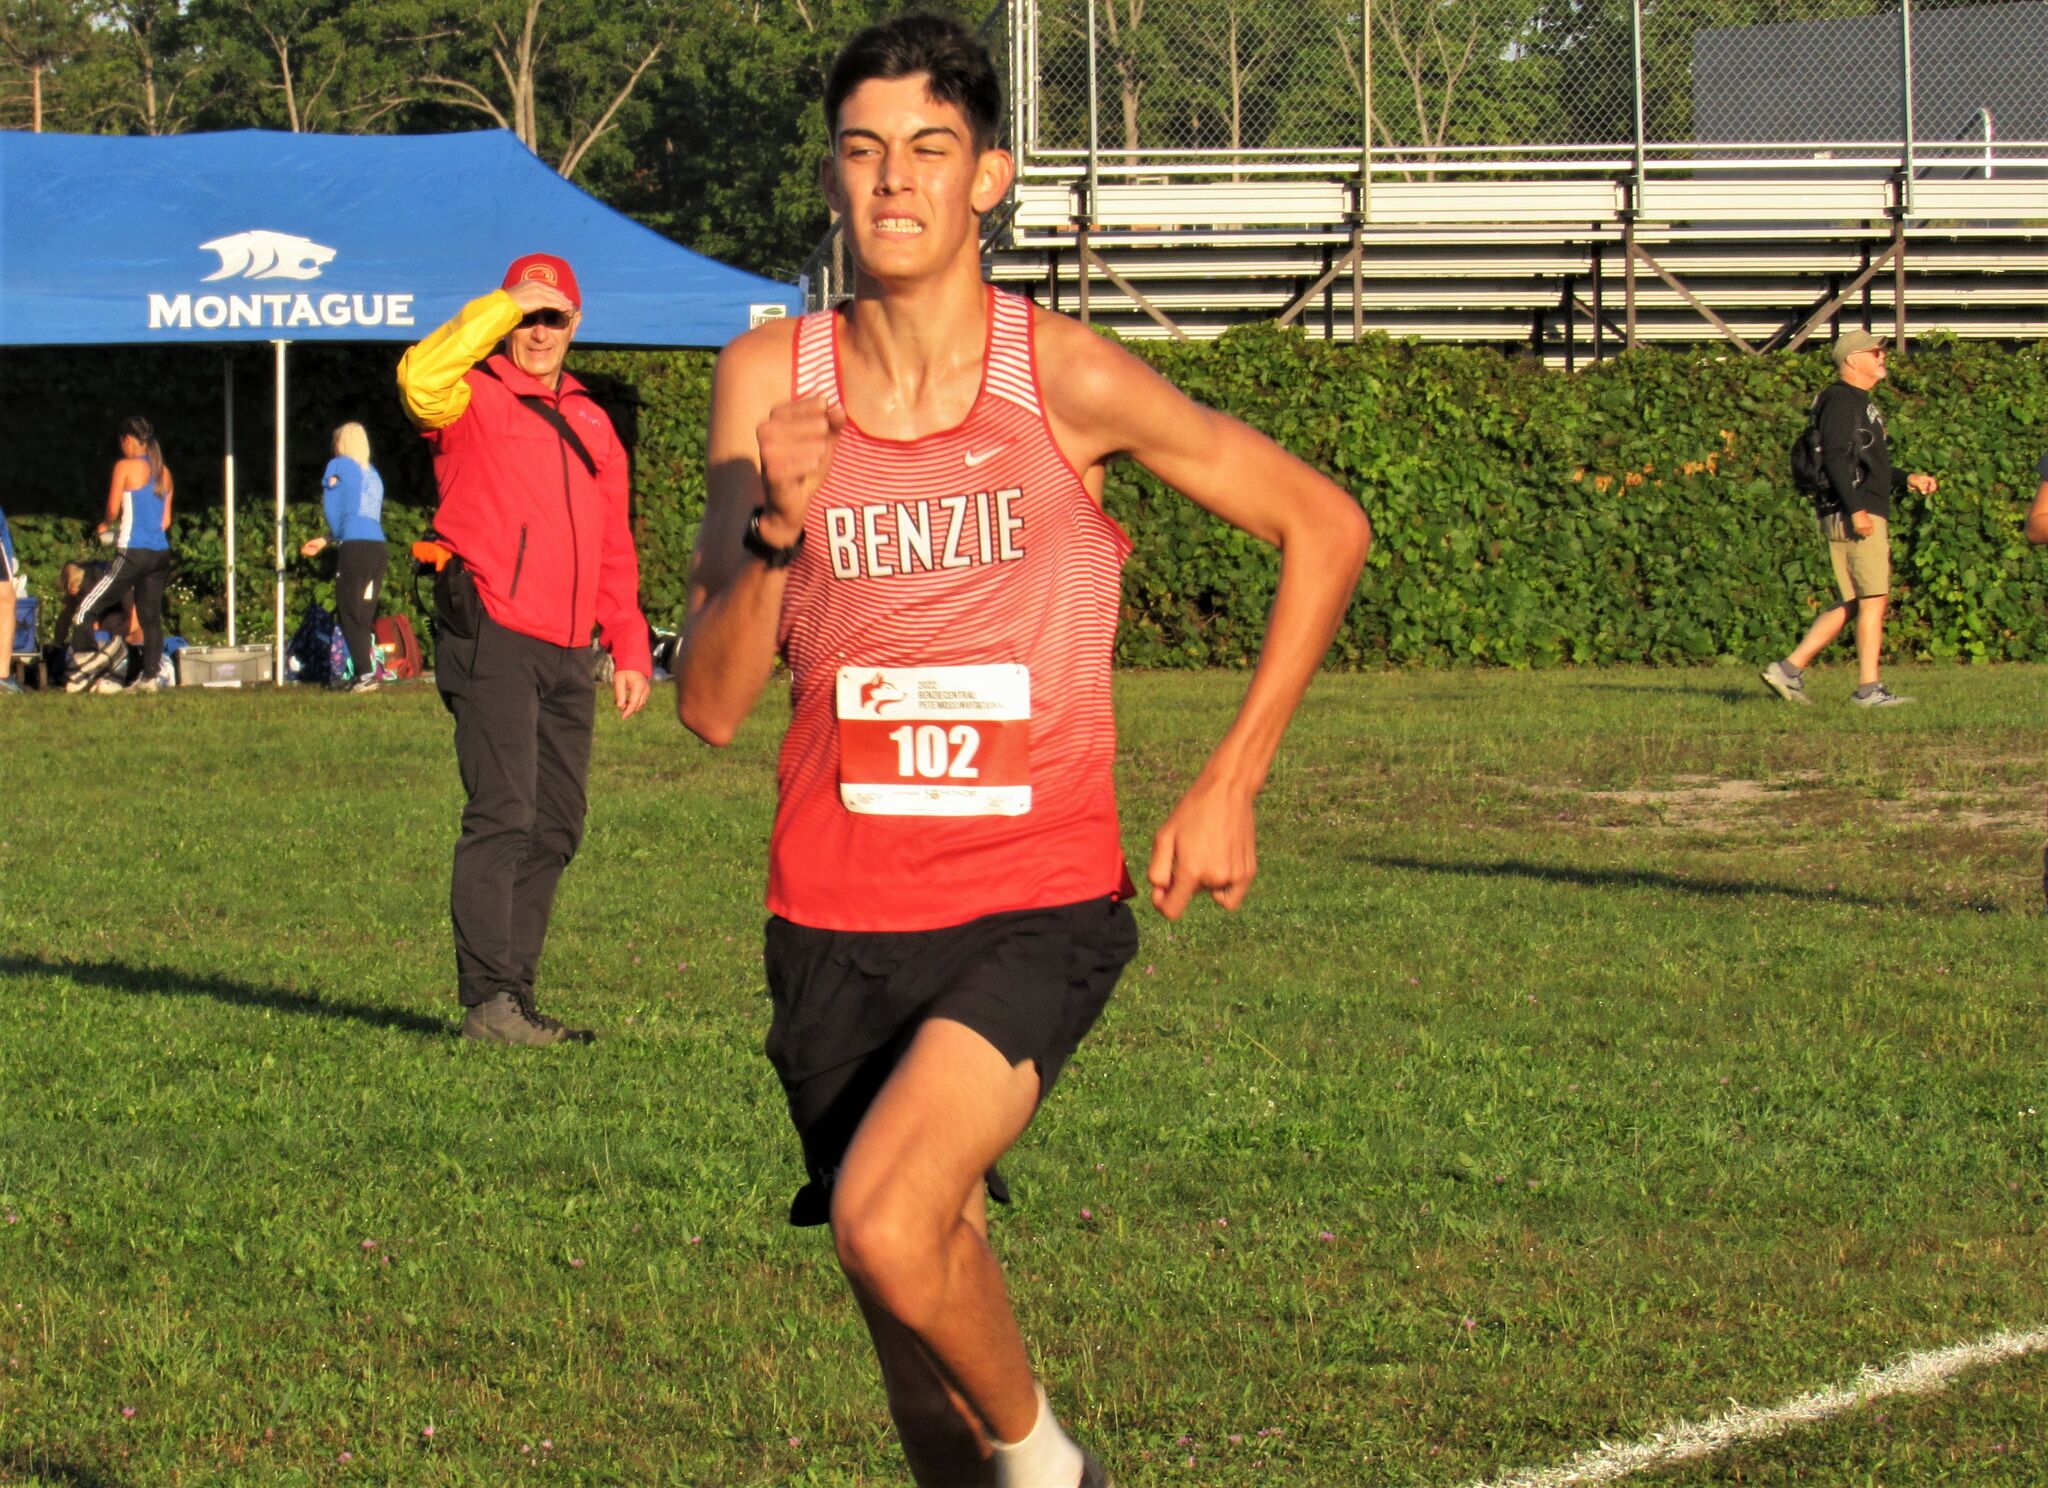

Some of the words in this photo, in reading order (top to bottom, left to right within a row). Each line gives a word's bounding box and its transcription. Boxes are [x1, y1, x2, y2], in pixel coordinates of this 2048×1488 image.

[148, 294, 415, 328] MONTAGUE
[824, 486, 1025, 580] BENZIE
[889, 725, 980, 778] 102
